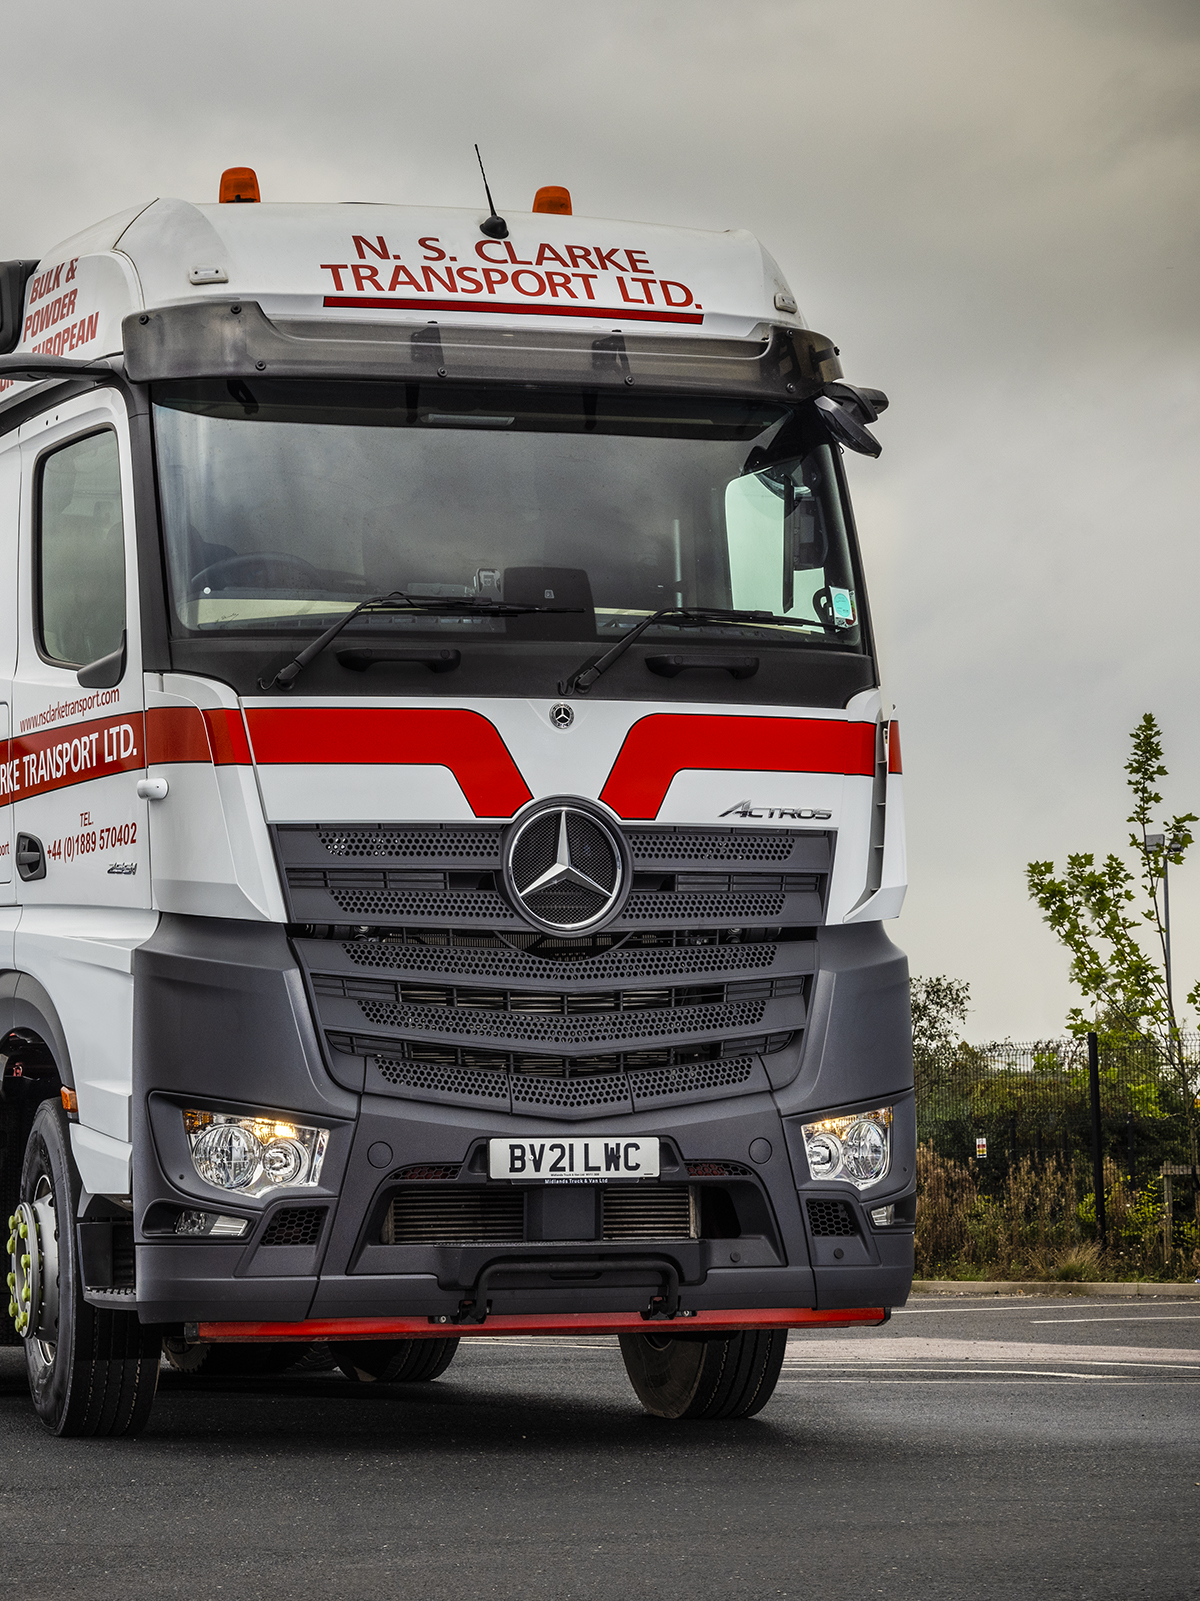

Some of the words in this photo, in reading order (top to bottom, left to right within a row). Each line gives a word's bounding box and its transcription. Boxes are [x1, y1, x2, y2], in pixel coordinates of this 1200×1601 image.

[351, 235, 401, 260] N.
[418, 236, 457, 262] S.
[475, 239, 655, 274] CLARKE
[29, 262, 66, 305] BULK
[65, 256, 80, 284] &
[320, 264, 598, 300] TRANSPORT
[616, 275, 704, 310] LTD.
[22, 288, 78, 343] POWDER
[31, 311, 100, 357] ROPEAN
[19, 688, 120, 733] www.nsclarketransport.com
[22, 732, 99, 788] TRANSPORT
[104, 723, 138, 764] LTD.
[79, 811, 94, 828] TEL.
[47, 839, 62, 862] +44
[63, 830, 97, 864] (0)1889
[99, 822, 137, 849] 570402
[508, 1143, 575, 1173] BV21
[584, 1142, 641, 1172] LWC
